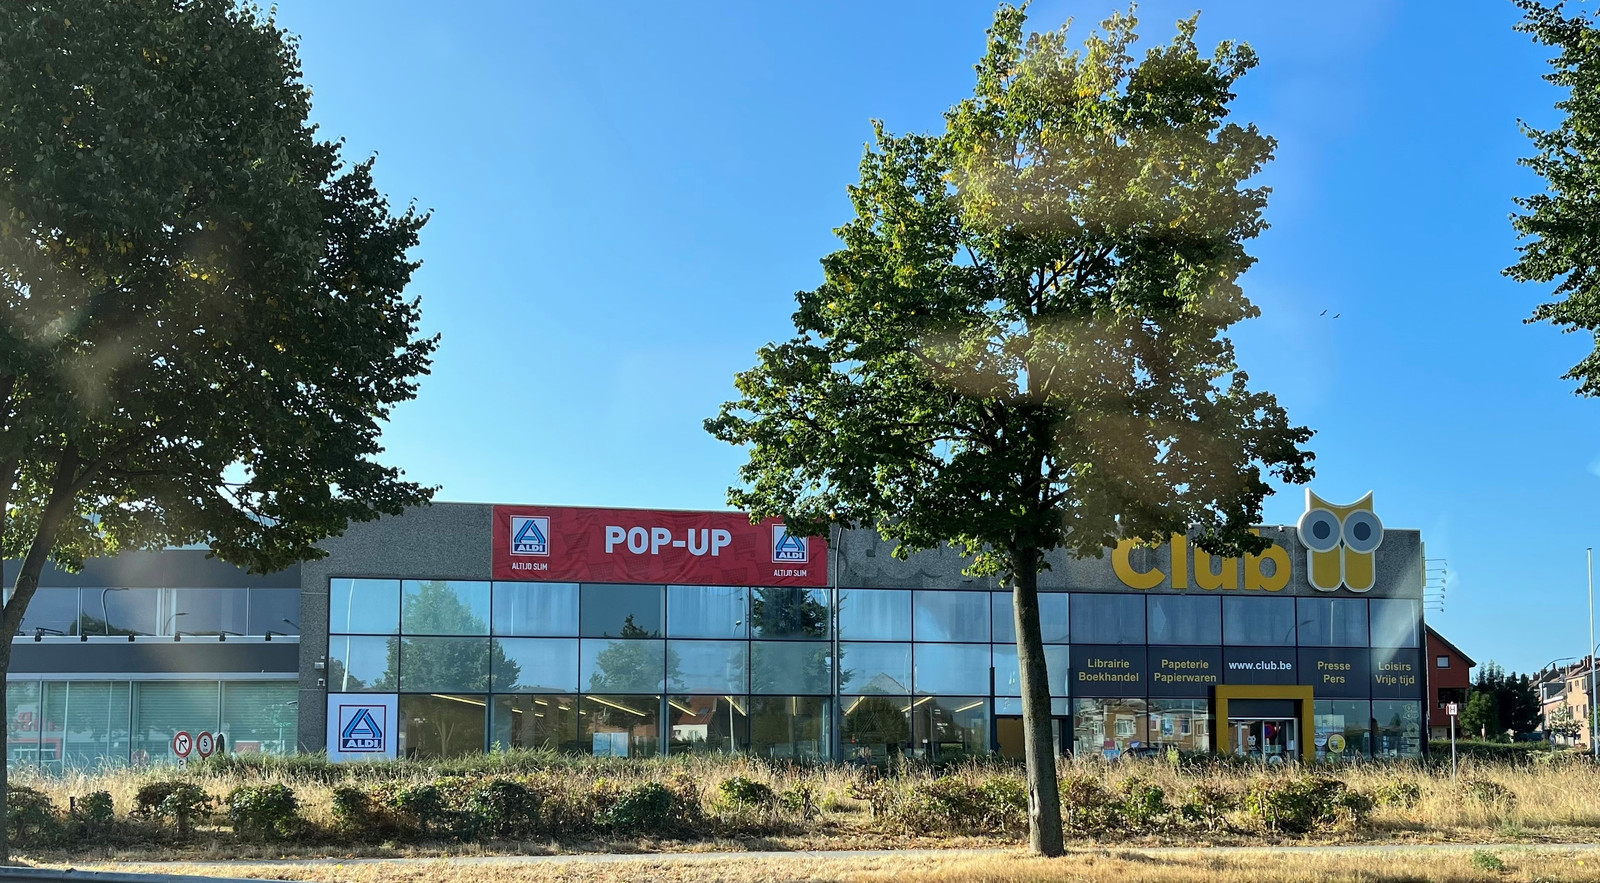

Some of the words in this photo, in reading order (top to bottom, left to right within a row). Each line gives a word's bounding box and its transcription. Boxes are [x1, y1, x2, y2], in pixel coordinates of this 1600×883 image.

[605, 525, 732, 556] POP-UP
[516, 544, 543, 552] ALDI
[1112, 529, 1291, 592] Club
[511, 562, 532, 570] ALTIJD
[533, 563, 548, 571] SLIM
[773, 569, 792, 577] ALTIJD
[793, 569, 807, 577] SLIM
[1087, 658, 1130, 668] Librairie
[1161, 659, 1209, 670] Papeterie
[1228, 660, 1292, 670] www.club.be
[1317, 661, 1351, 671] Presse
[1378, 661, 1411, 671] Loisirs
[1078, 672, 1139, 682] Boekhandel
[1154, 672, 1217, 683] Papierwaren
[1323, 674, 1345, 684] Pers
[1375, 674, 1397, 684] Vrije
[1399, 674, 1415, 685] tijd
[203, 738, 208, 747] 5
[345, 739, 379, 748] ALDI
